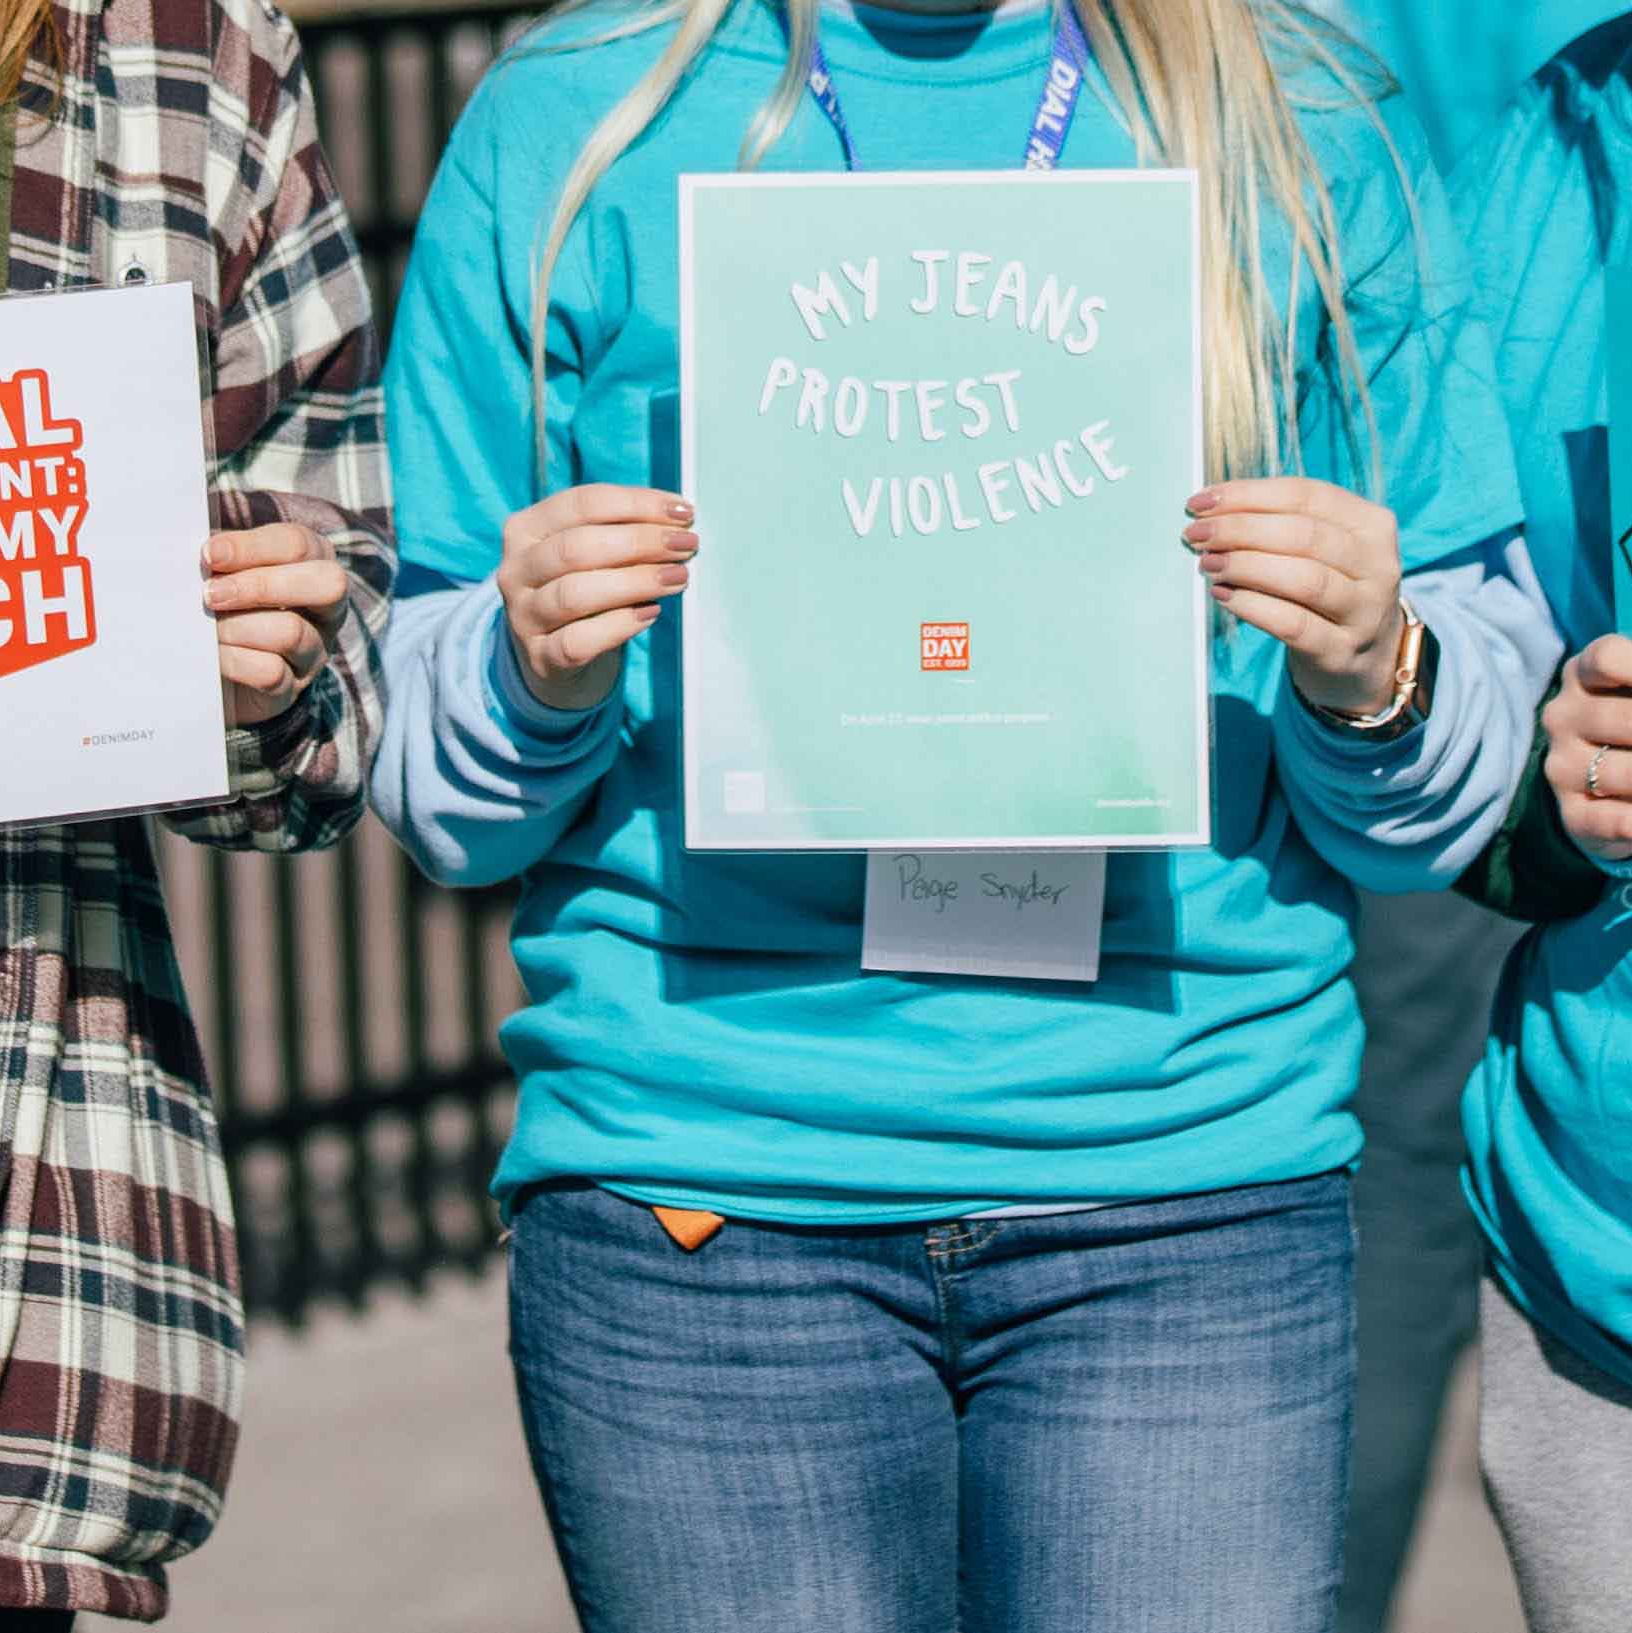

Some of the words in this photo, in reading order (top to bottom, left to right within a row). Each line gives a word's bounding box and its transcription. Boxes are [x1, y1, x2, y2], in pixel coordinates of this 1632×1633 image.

[1035, 57, 1078, 133] DIAL
[790, 256, 880, 342] MY
[910, 249, 1106, 355] JEANS
[758, 357, 1022, 443] PROTEST
[841, 419, 1129, 538] VIOLENCE
[922, 638, 968, 657] DAY
[81, 729, 155, 746] #DENIMDAY
[980, 869, 1070, 911] Snyder
